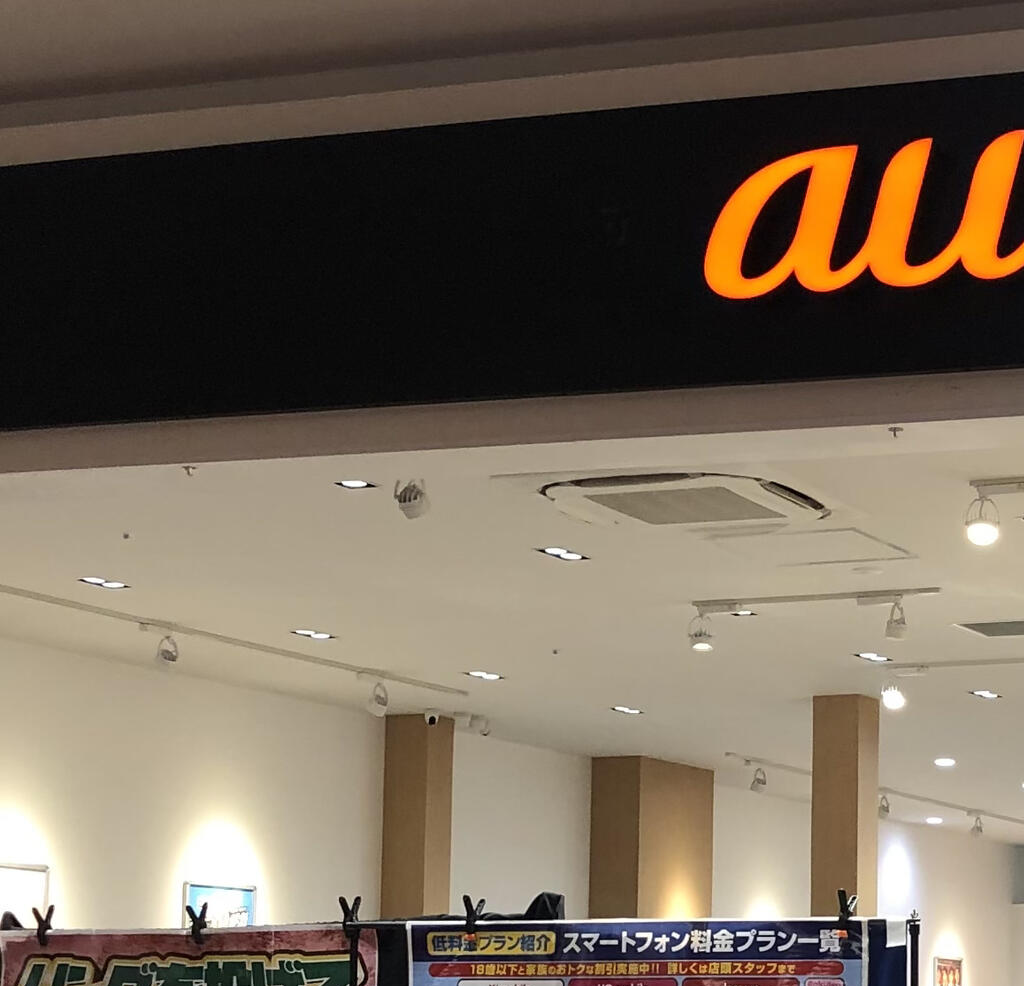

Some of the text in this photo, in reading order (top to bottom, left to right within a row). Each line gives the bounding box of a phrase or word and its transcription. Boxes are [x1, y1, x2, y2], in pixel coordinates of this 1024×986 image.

[563, 929, 841, 953] スマートフォン料金プラン一覧
